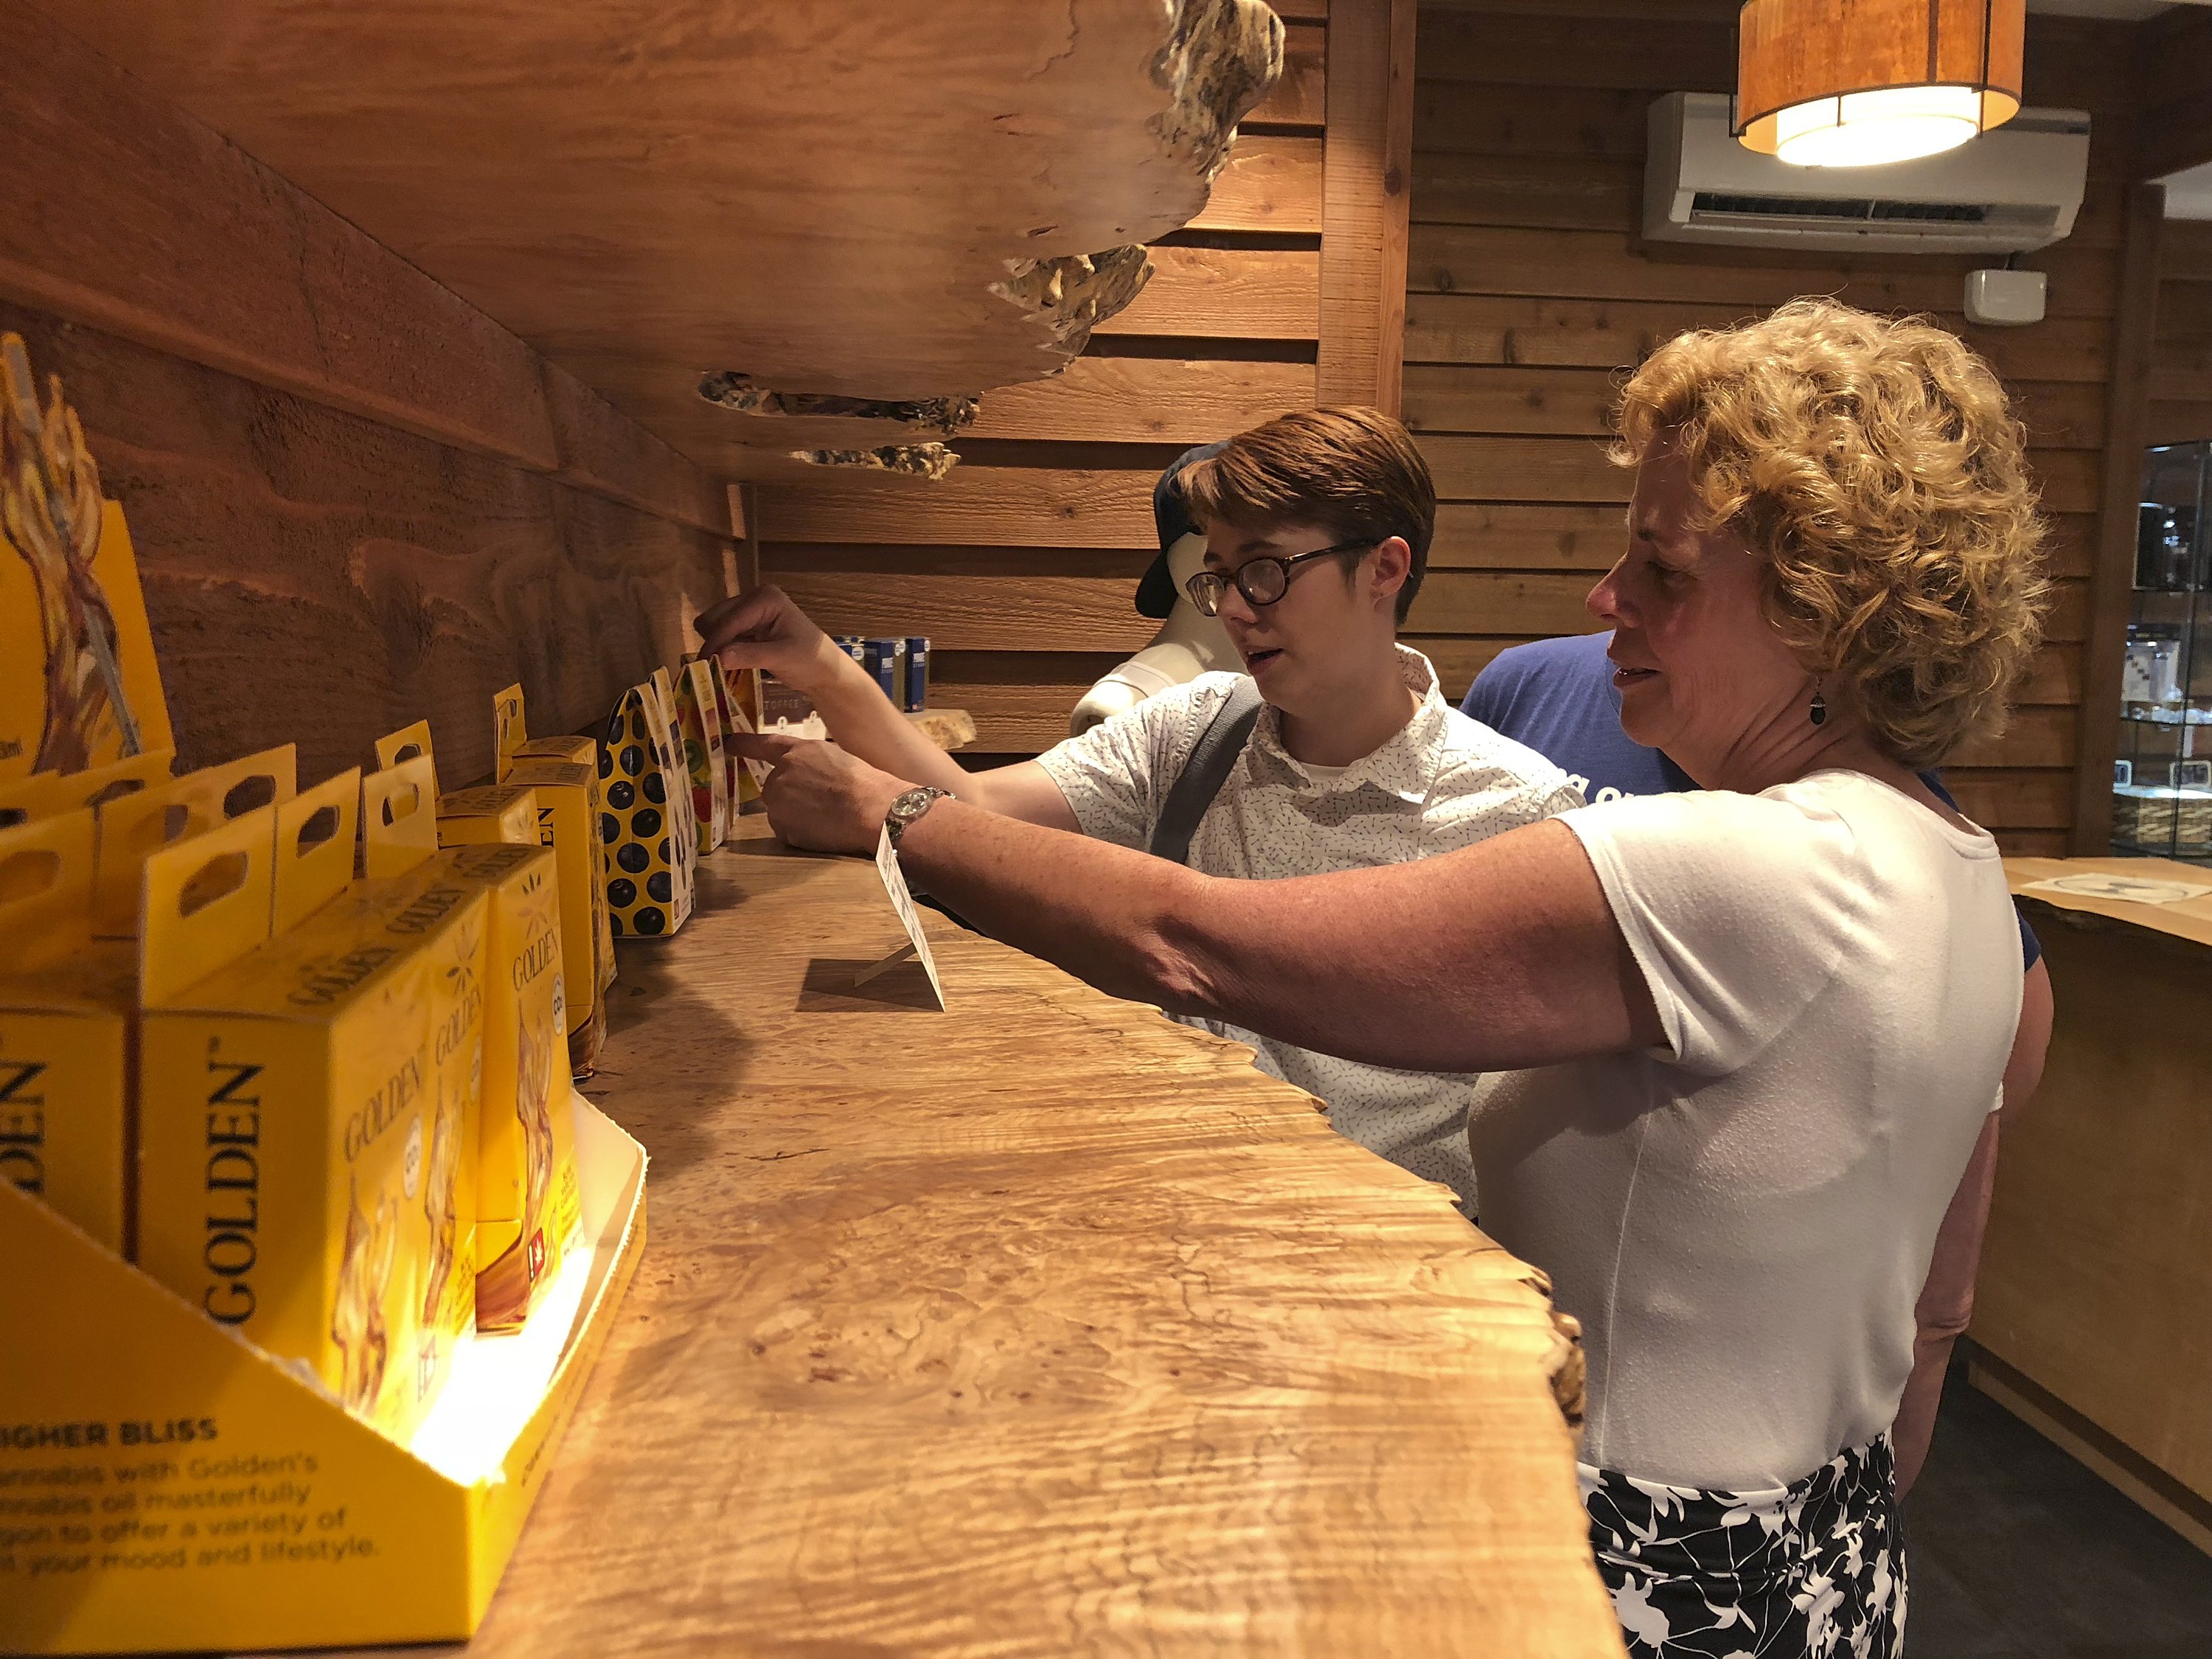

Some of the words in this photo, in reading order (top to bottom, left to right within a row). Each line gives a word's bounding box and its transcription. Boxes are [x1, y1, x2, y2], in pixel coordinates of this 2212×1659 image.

[119, 1418, 218, 1446] BLISS
[114, 1459, 179, 1484] with
[187, 1452, 319, 1480] Golden's
[145, 1481, 313, 1511] masterfully
[206, 1512, 308, 1537] variety
[317, 1505, 347, 1531] of
[101, 1548, 187, 1571] mood
[196, 1542, 251, 1568] and
